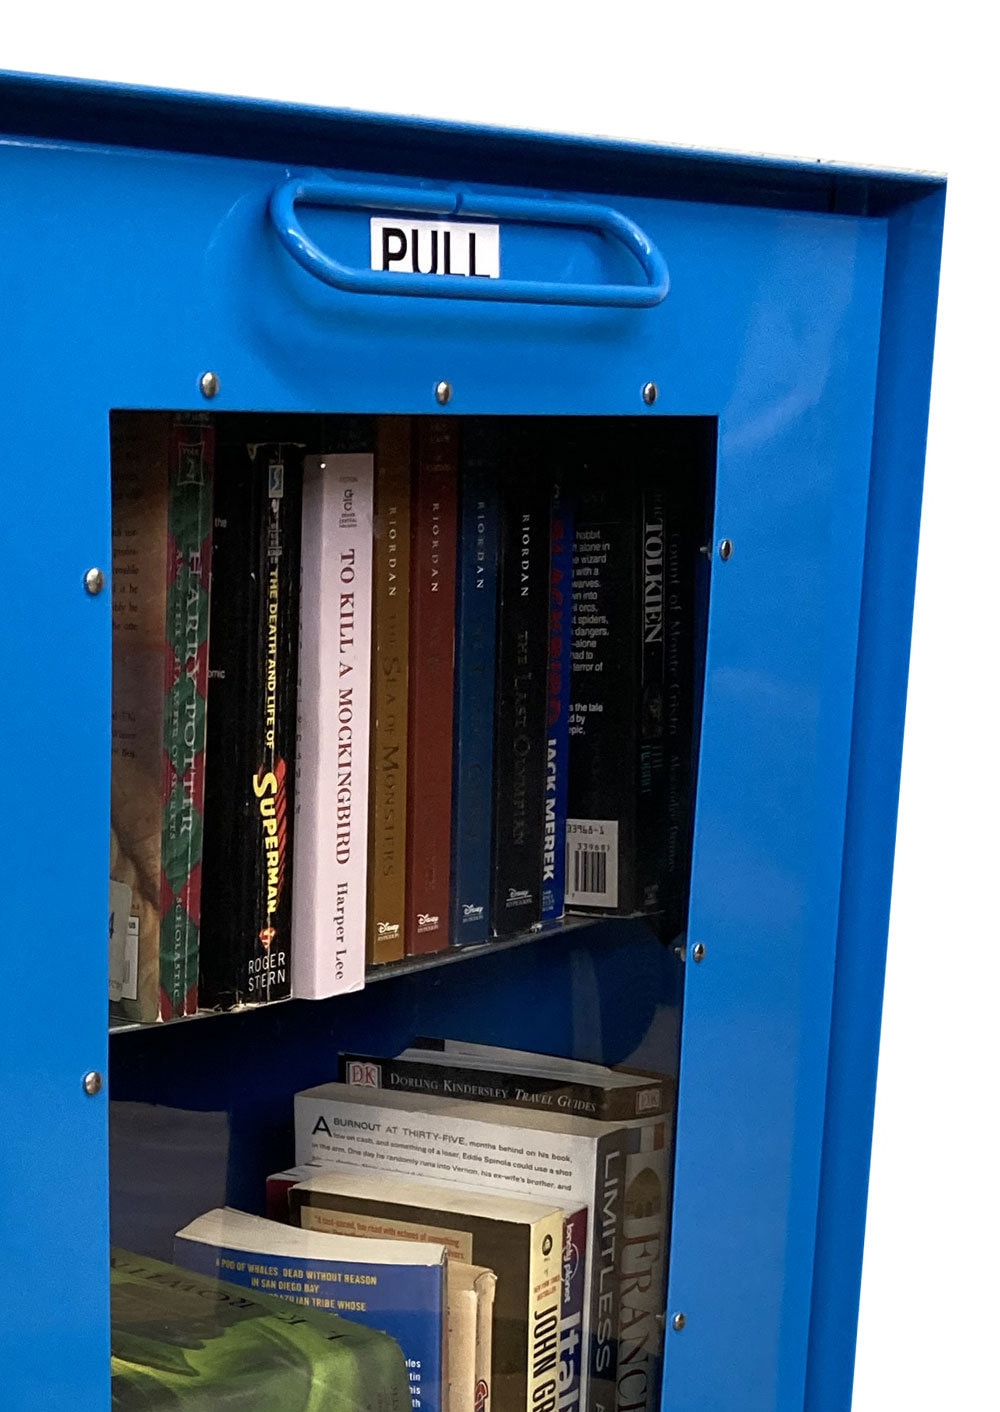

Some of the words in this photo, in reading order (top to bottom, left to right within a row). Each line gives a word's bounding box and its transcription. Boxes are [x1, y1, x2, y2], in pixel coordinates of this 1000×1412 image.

[382, 227, 491, 278] PULL
[340, 548, 355, 584] TO
[388, 506, 398, 597] RIORDAN
[431, 502, 440, 592] RIORDAN
[476, 501, 486, 589] RIORDAN
[520, 514, 531, 597] RIORDAN
[269, 566, 279, 597] THE
[645, 522, 663, 643] TOLKIEN
[185, 546, 201, 682] HARRY
[267, 600, 279, 655] DEATH
[339, 592, 355, 653] KILL
[266, 660, 277, 691] AND
[338, 662, 353, 678] A
[266, 696, 276, 726] LIFE
[265, 733, 275, 749] OF
[179, 702, 197, 837] POTTER
[335, 687, 353, 865] MOCKINGBIRD
[546, 738, 558, 791] JACK
[252, 771, 280, 914] SUPERMAN
[543, 798, 556, 881] MEREK
[333, 882, 348, 943] Harper
[376, 922, 400, 934] Disney
[417, 914, 440, 925] Disney
[172, 896, 183, 998] SCHOLASTIC
[248, 952, 287, 972] ROGER
[335, 949, 347, 980] Lee
[248, 970, 287, 992] STERN
[351, 1064, 377, 1087] DK
[390, 1073, 439, 1090] DORLING
[443, 1079, 509, 1100] KINDERSLEY
[514, 1088, 553, 1105] TRAVEL
[557, 1095, 597, 1113] GUIDES
[312, 1116, 332, 1137] A
[334, 1118, 381, 1132] BURNOUT
[386, 1126, 398, 1134] AT
[402, 1128, 468, 1147] THIRTY-FIVE,
[469, 1140, 497, 1151] months
[498, 1144, 524, 1155] behind
[526, 1150, 536, 1158] on
[538, 1151, 549, 1159] his
[551, 1153, 573, 1164] book,
[376, 1139, 390, 1147] and
[390, 1141, 427, 1154] something
[427, 1147, 436, 1155] of
[462, 1152, 482, 1162] Eddie
[513, 1161, 533, 1171] could
[555, 1168, 572, 1177] shot
[348, 1147, 361, 1156] One
[363, 1149, 375, 1159] day
[376, 1152, 385, 1160] he
[387, 1153, 419, 1166] randomly
[420, 1160, 436, 1168] runs
[437, 1162, 451, 1171] into
[481, 1170, 492, 1178] his
[557, 1183, 572, 1191] and
[563, 1222, 575, 1261] lonely
[595, 1150, 620, 1373] LIMITLESS
[236, 1262, 246, 1272] OF
[247, 1263, 279, 1276] WHALES
[282, 1269, 304, 1279] DEAD
[306, 1270, 342, 1283] WITHOUT
[344, 1275, 377, 1286] REASON
[251, 1278, 259, 1288] IN
[261, 1278, 276, 1289] SAN
[278, 1281, 302, 1292] DIEGO
[304, 1283, 320, 1293] BAY
[563, 1263, 574, 1303] planet
[312, 1297, 335, 1309] TRIBE
[337, 1300, 367, 1312] WHOSE
[533, 1304, 558, 1379] JOHN
